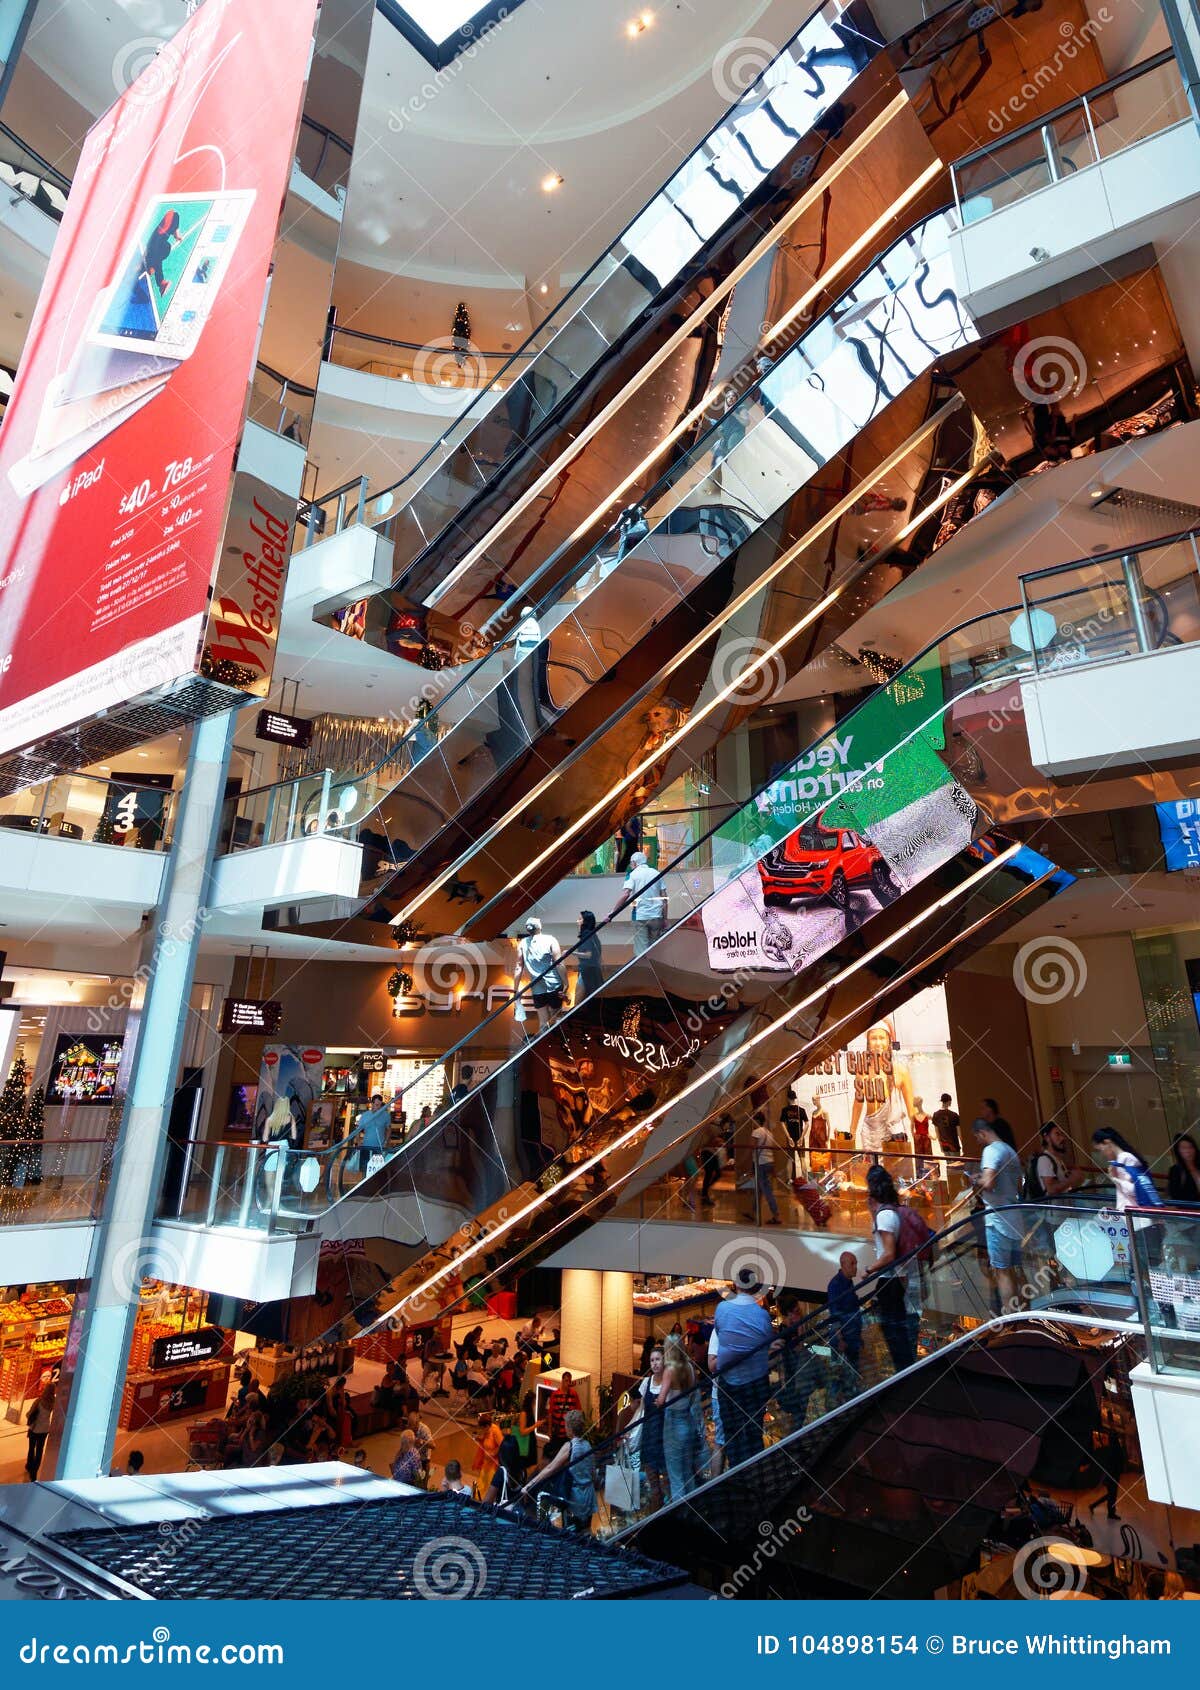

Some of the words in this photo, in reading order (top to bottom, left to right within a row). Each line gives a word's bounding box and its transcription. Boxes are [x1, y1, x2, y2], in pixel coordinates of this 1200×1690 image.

[69, 458, 105, 498] iPad
[118, 479, 150, 515] $40
[162, 457, 193, 492] 7GB
[210, 496, 289, 673] Westfield
[117, 792, 138, 813] 4
[113, 812, 137, 833] 3
[846, 1051, 893, 1075] GIFTS
[815, 1082, 836, 1096] UNDER
[853, 1078, 886, 1103] SUN
